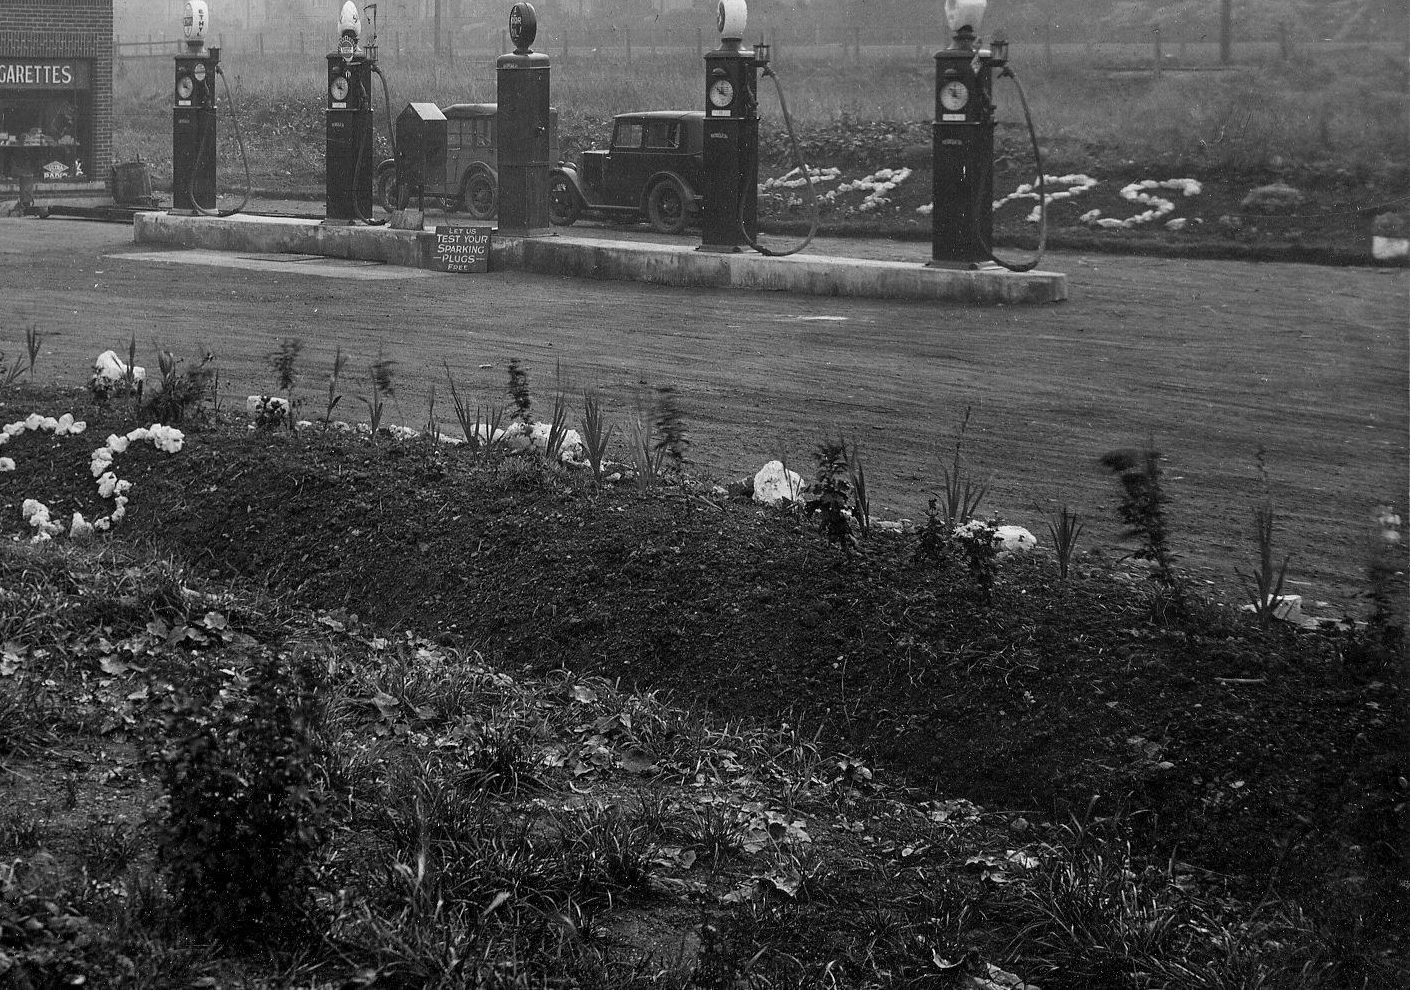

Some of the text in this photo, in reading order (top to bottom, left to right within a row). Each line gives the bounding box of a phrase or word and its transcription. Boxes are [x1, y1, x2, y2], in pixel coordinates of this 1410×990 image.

[437, 234, 489, 244] TEST YOUR
[437, 243, 485, 254] SPARKING
[447, 263, 469, 271] FREE
